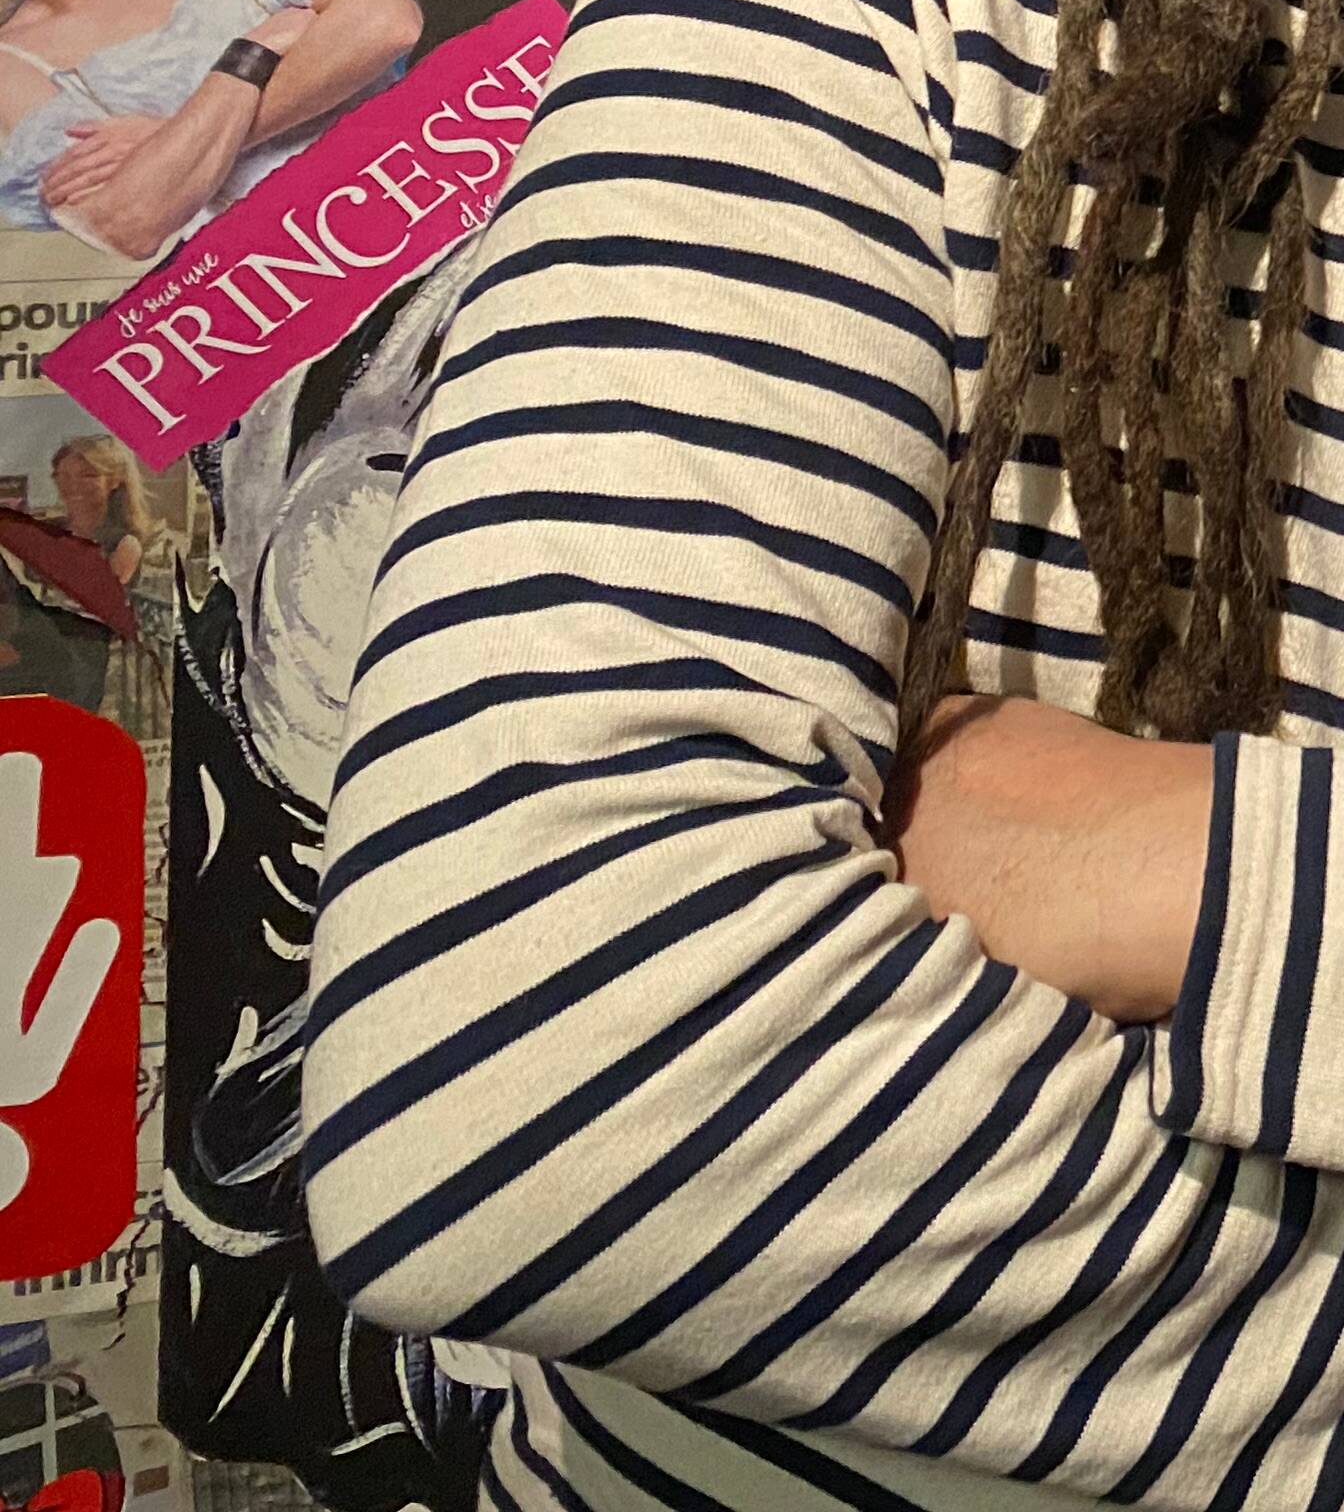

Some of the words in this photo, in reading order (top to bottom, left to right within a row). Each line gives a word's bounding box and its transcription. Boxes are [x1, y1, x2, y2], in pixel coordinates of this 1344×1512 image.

[92, 34, 560, 437] PRINCESSE
[143, 281, 182, 313] suis
[181, 251, 220, 288] une
